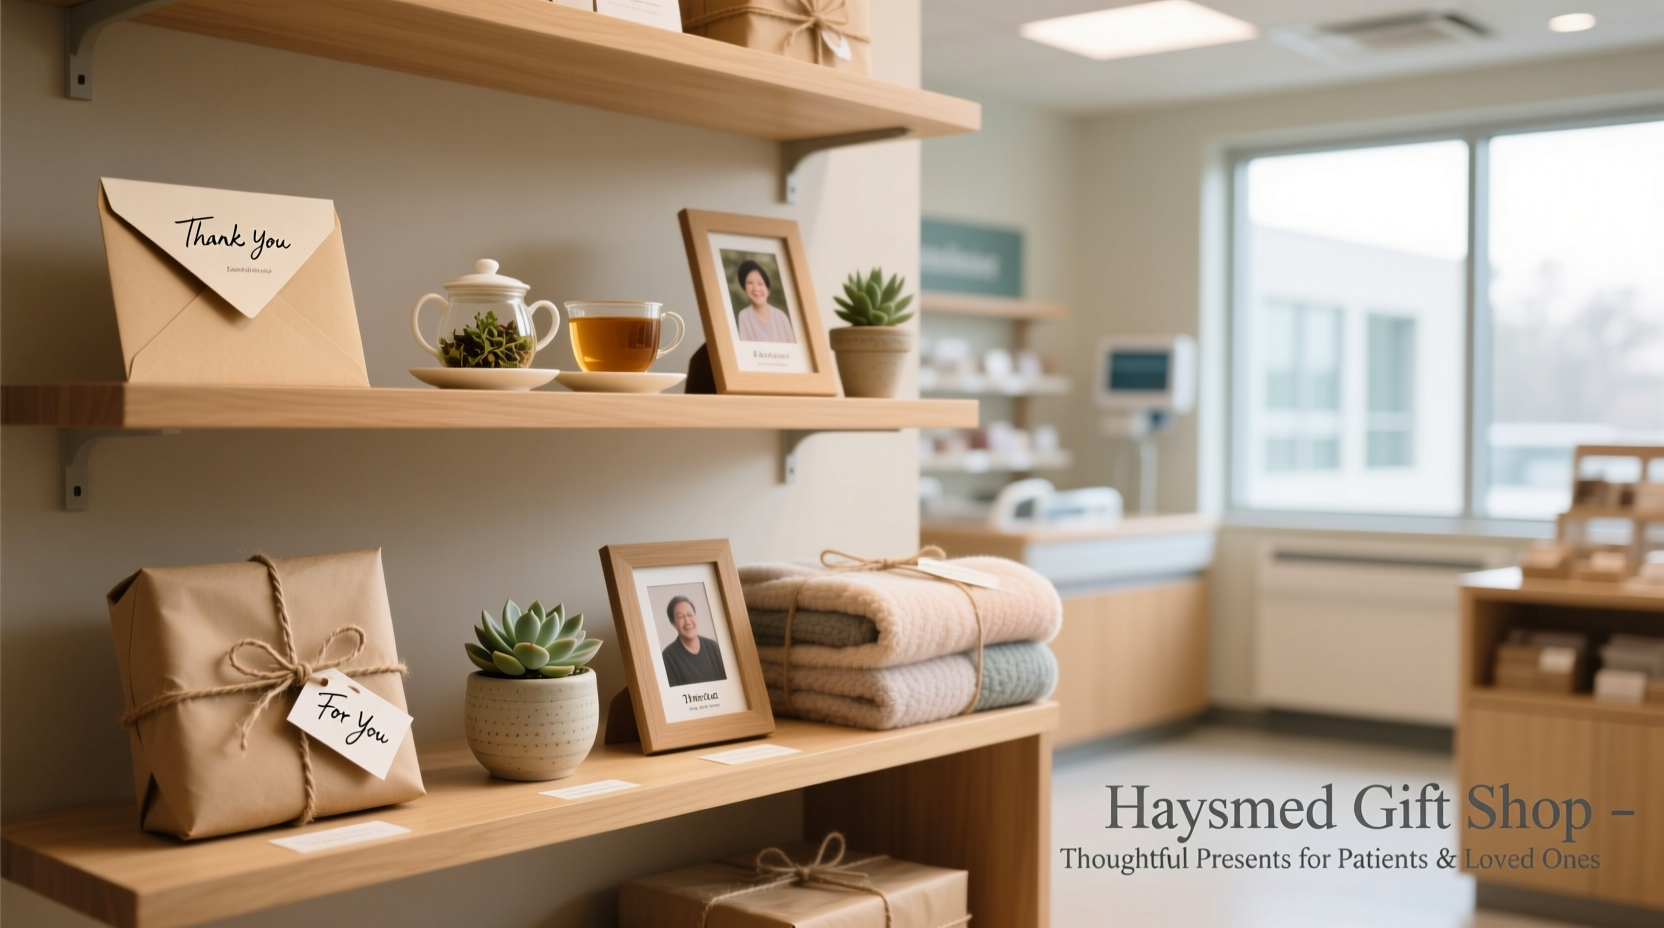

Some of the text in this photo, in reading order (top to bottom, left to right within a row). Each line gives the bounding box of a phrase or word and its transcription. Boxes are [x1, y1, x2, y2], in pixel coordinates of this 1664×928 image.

[174, 216, 291, 260] Thank You
[317, 692, 389, 745] For You
